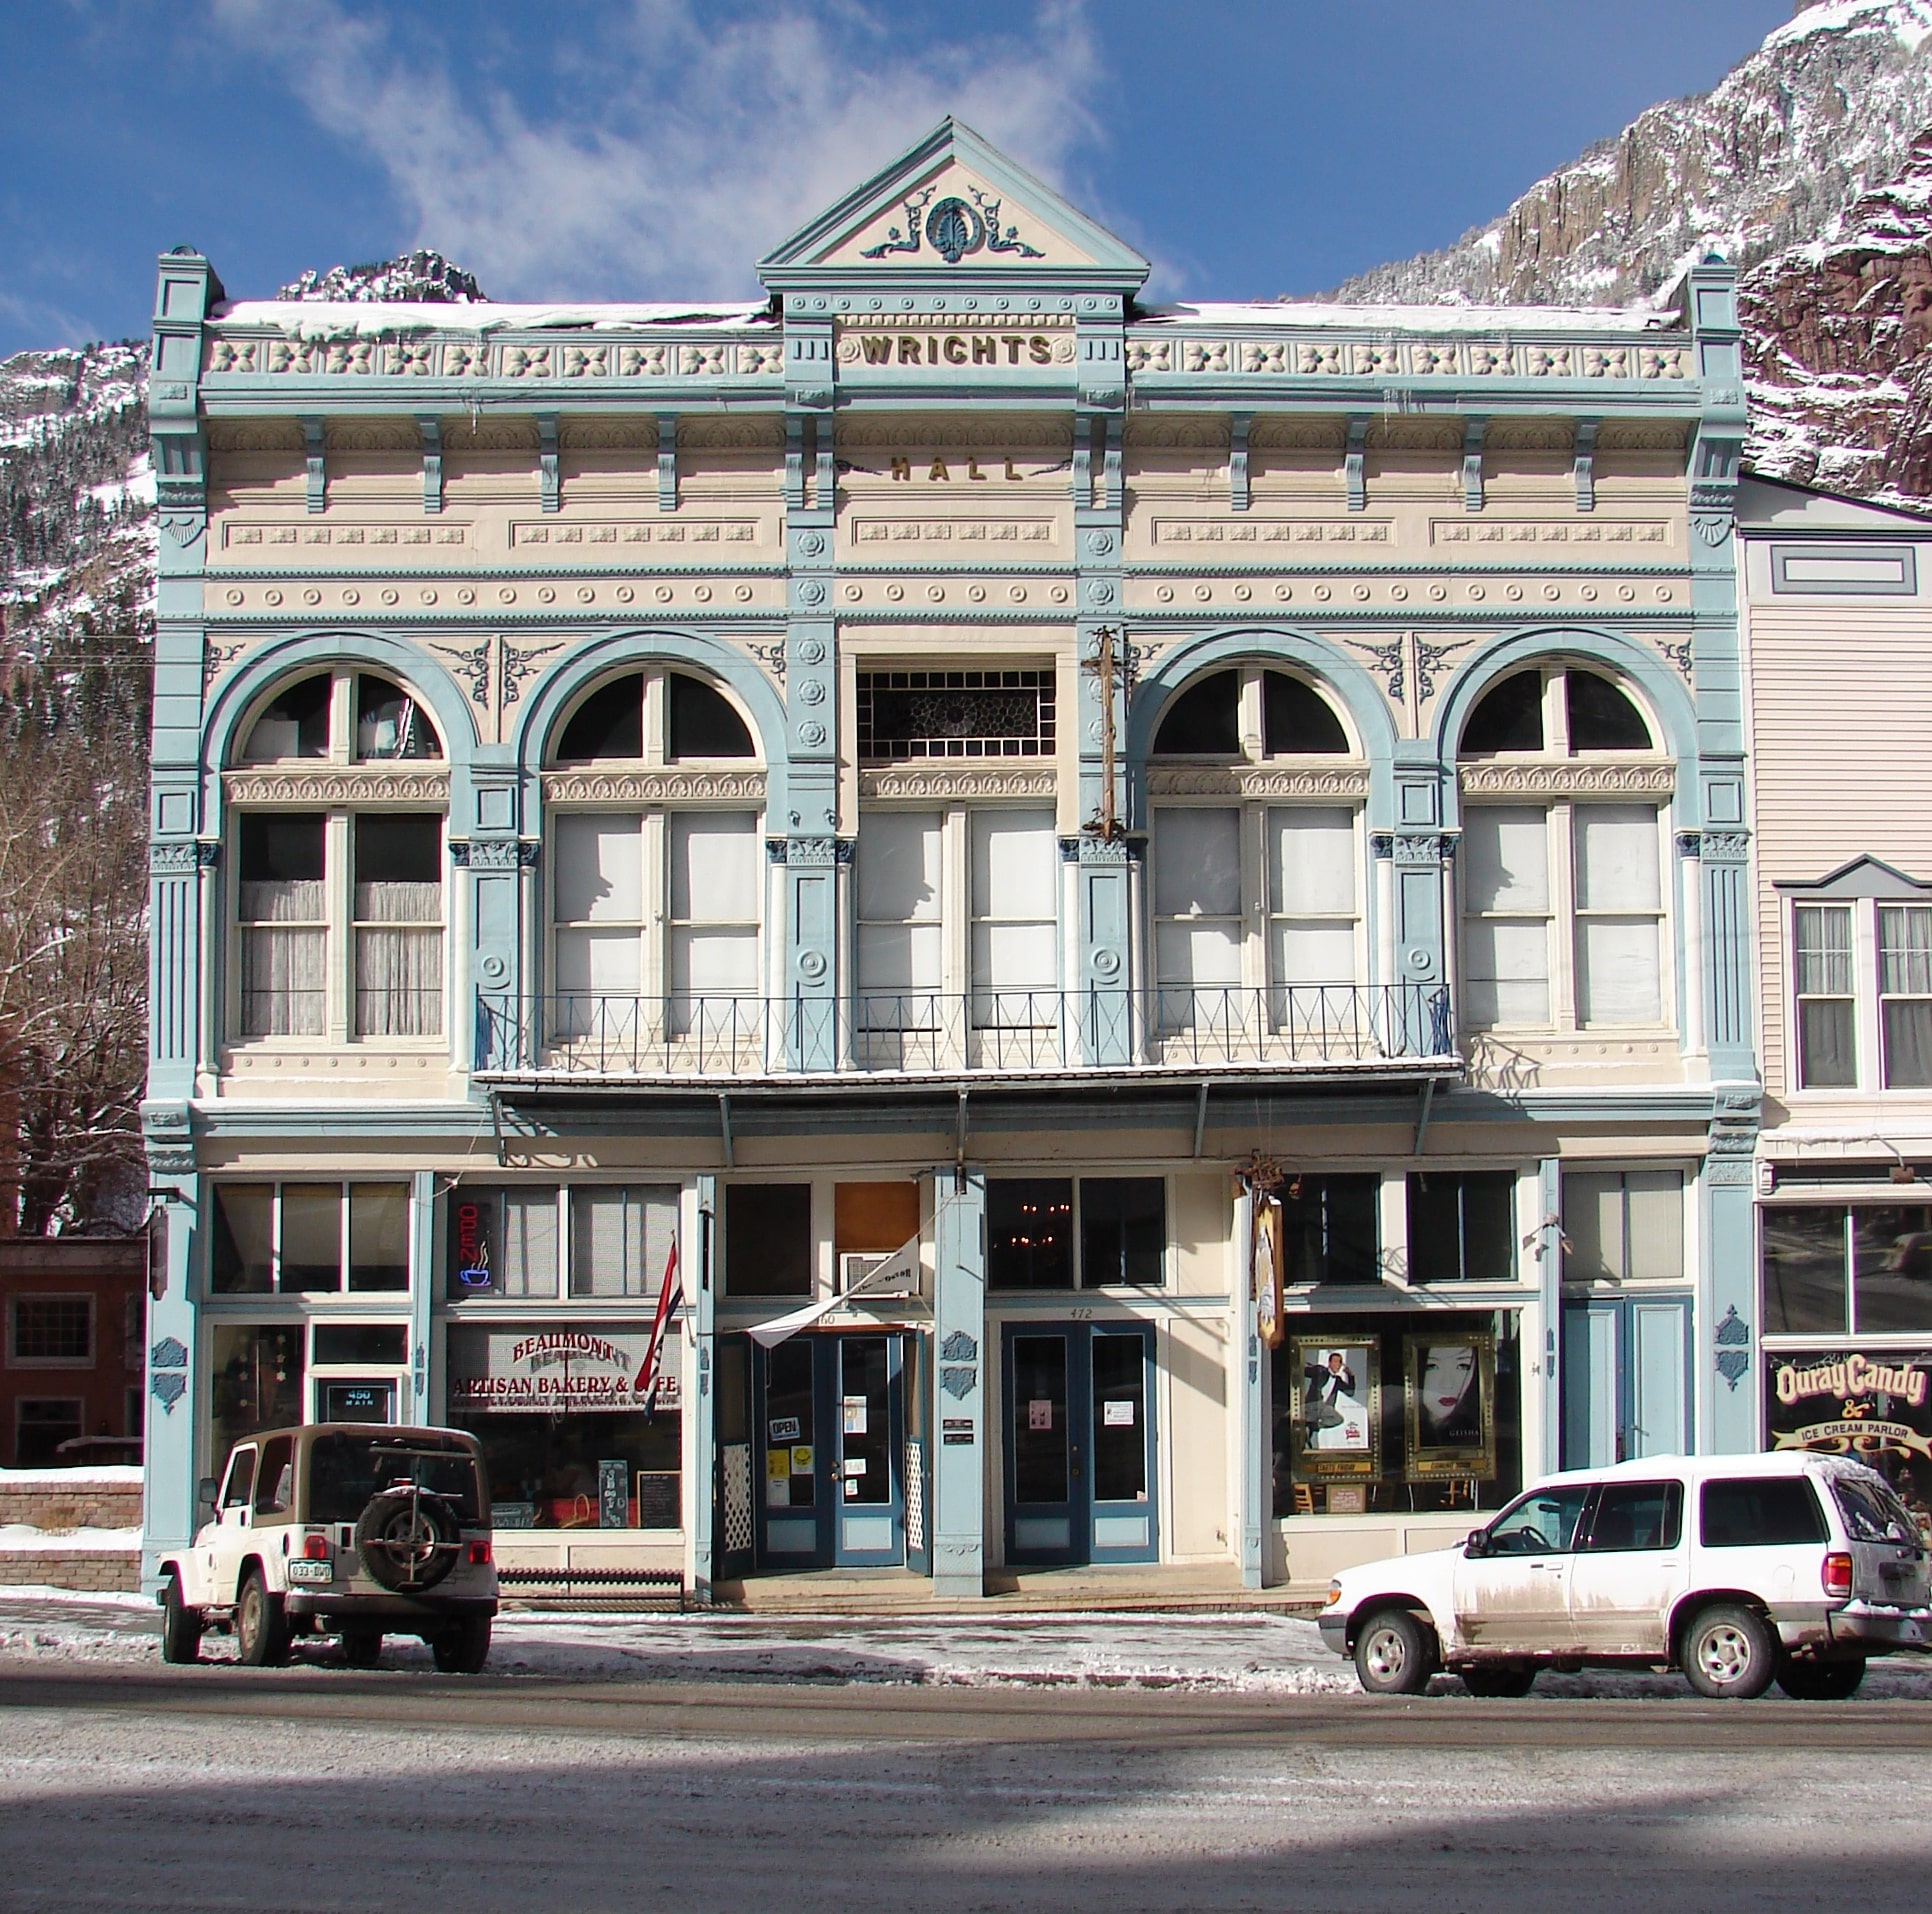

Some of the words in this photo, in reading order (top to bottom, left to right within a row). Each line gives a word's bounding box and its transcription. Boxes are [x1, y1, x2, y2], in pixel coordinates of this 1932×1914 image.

[861, 335, 1052, 364] WRIGHTS
[891, 457, 1023, 481] HALL
[459, 1205, 478, 1262] OPEN
[1070, 1308, 1093, 1319] 472
[512, 1332, 614, 1363] BEAUMONT
[454, 1377, 532, 1393] ARTISAN
[538, 1376, 611, 1393] BAKERY
[615, 1376, 629, 1392] &
[1776, 1363, 1848, 1405] Ouray
[1847, 1354, 1927, 1406] Candy
[348, 1390, 371, 1399] 450
[1842, 1399, 1870, 1418] &
[772, 1420, 797, 1435] OPEN
[1801, 1428, 1820, 1441] ICE
[1824, 1423, 1863, 1436] CREAM
[1867, 1423, 1908, 1439] PARLOR
